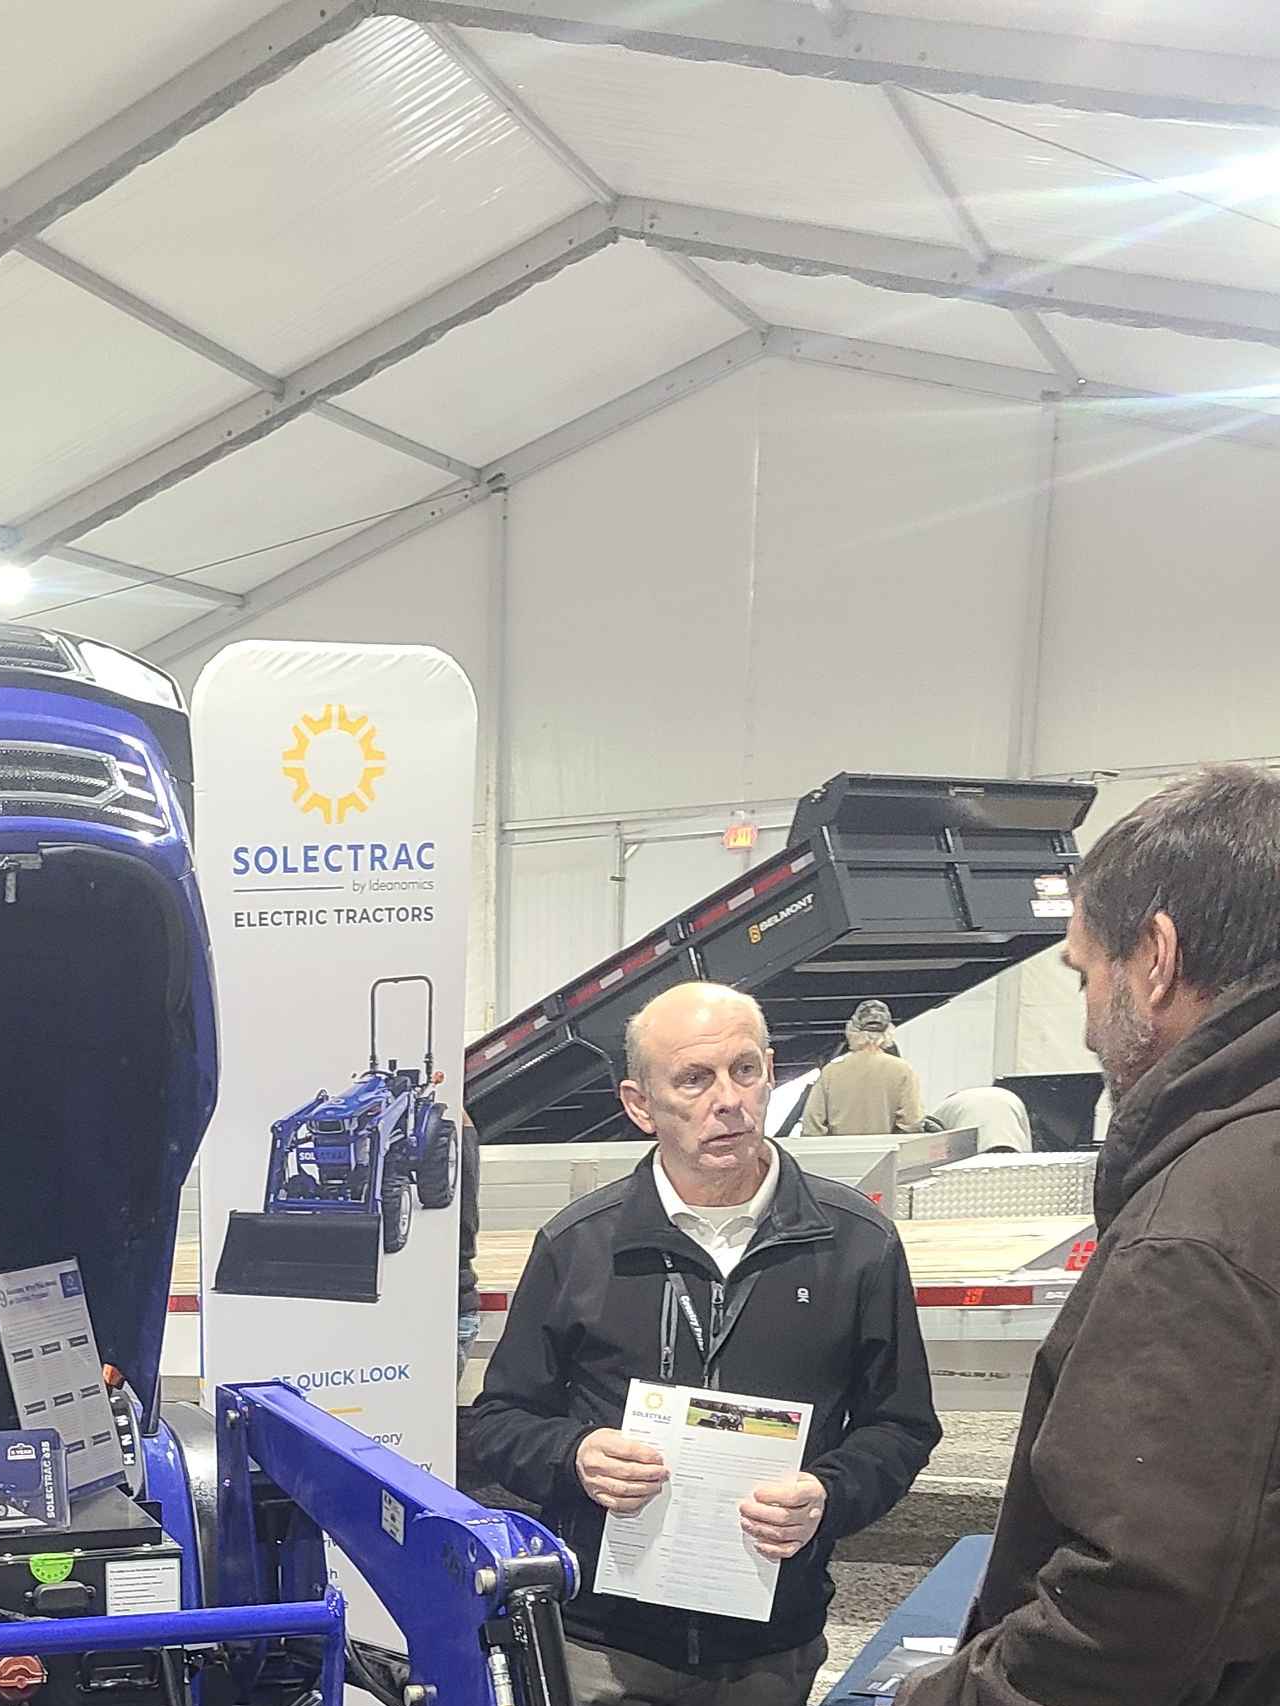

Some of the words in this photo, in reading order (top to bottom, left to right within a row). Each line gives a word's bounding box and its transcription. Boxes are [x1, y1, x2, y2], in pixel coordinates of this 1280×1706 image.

[232, 842, 435, 875] SOLECTRAC
[352, 880, 366, 894] by
[369, 879, 434, 891] Ideanomics
[234, 909, 328, 927] ELECTRIC
[333, 906, 434, 924] TRACTORS
[297, 1369, 355, 1391] QUICK
[360, 1364, 410, 1383] LOOK
[43, 1459, 55, 1518] SOLECTRAC
